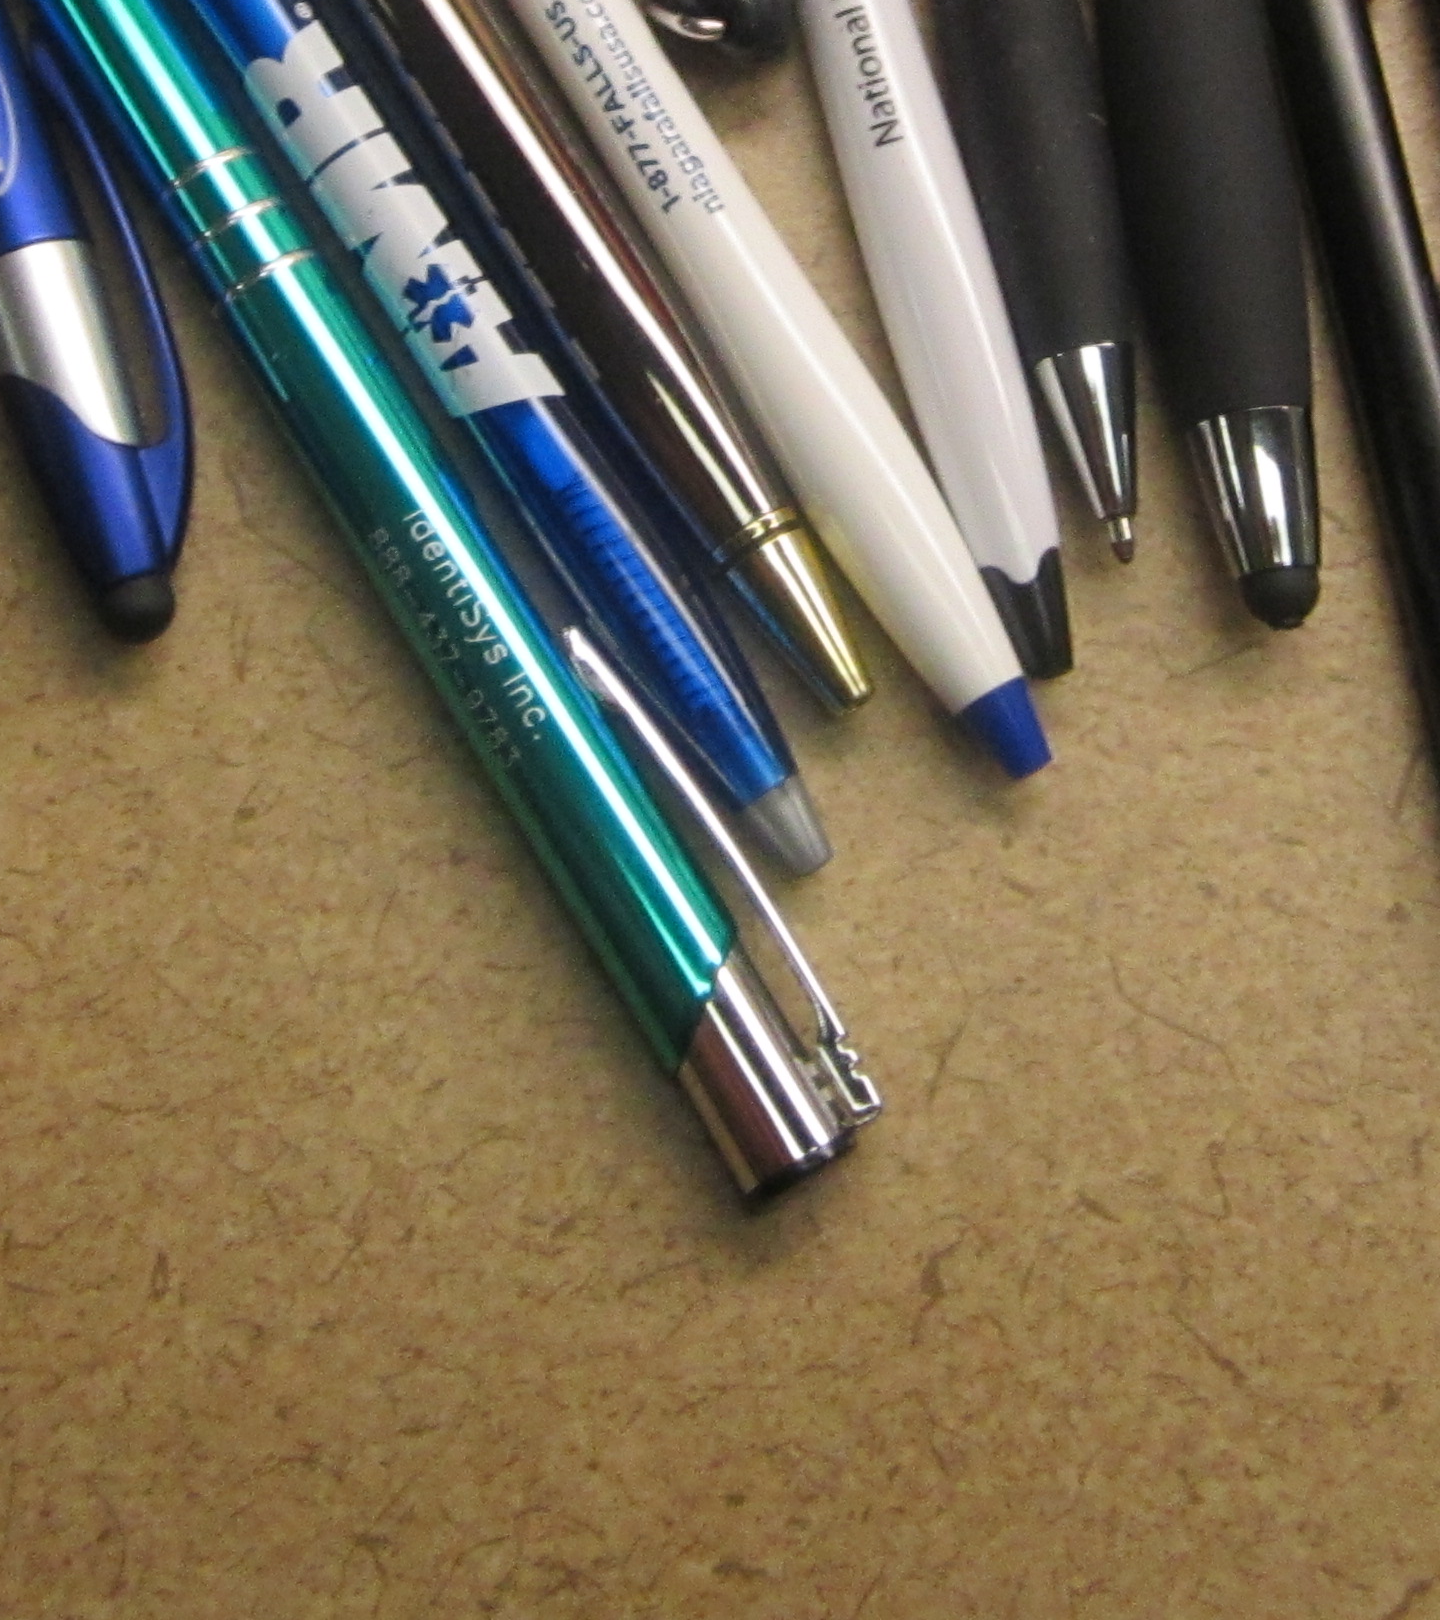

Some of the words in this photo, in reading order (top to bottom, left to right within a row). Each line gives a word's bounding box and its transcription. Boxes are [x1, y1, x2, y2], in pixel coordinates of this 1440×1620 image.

[833, 4, 903, 147] National
[246, 24, 564, 417] AMR
[401, 510, 509, 664] IdentiSys
[501, 671, 548, 740] Inc.
